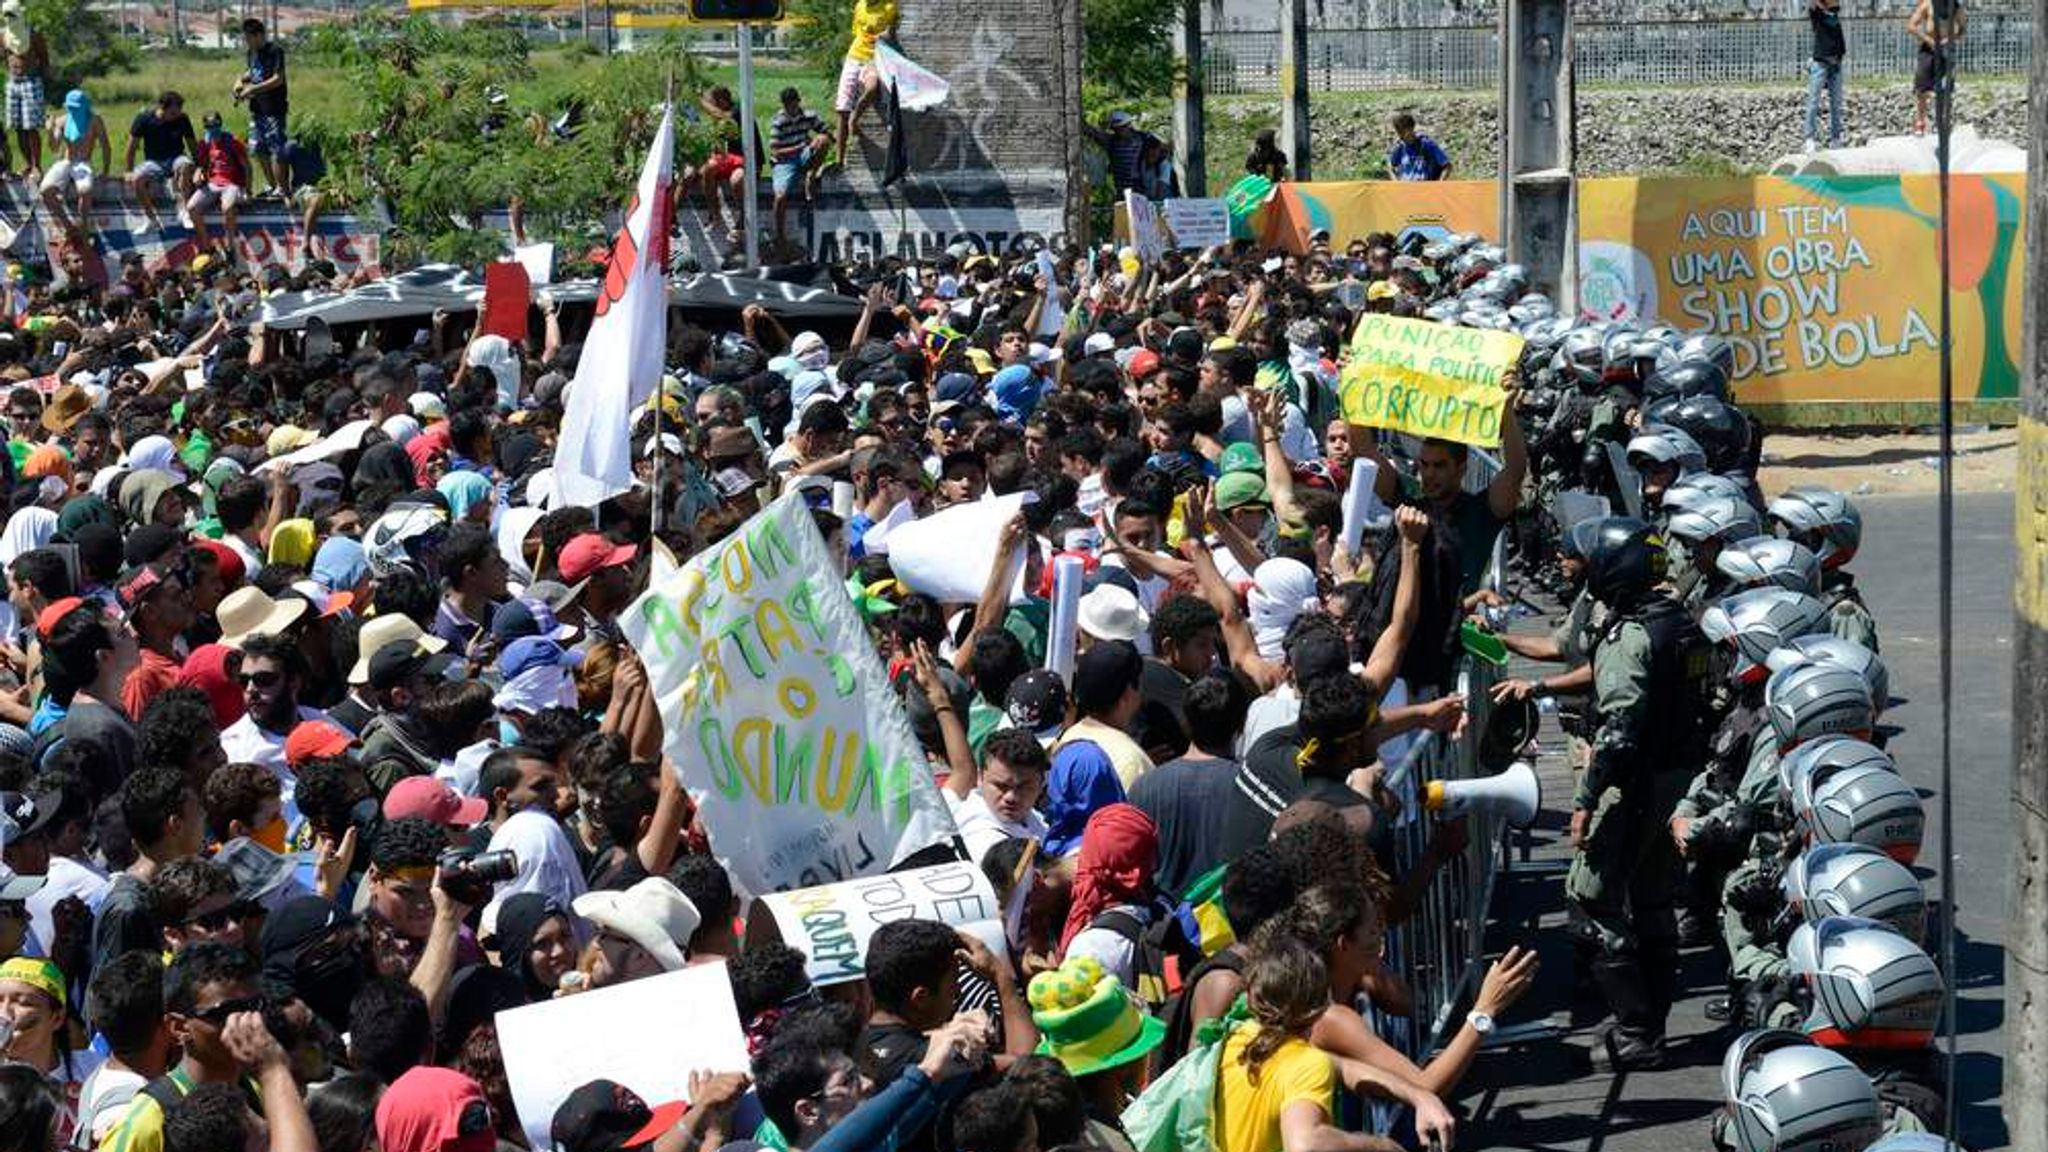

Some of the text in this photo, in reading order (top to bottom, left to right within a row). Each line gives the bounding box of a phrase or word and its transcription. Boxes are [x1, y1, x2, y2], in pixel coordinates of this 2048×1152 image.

[1682, 206, 1848, 241] AQUI TEM
[1670, 237, 1873, 286] UMA OBRA
[1682, 271, 1838, 334] SHOW
[1428, 354, 1501, 387] POLÍTIC
[1723, 306, 1940, 379] DE BOLA
[1340, 376, 1498, 440] CORRUPTO
